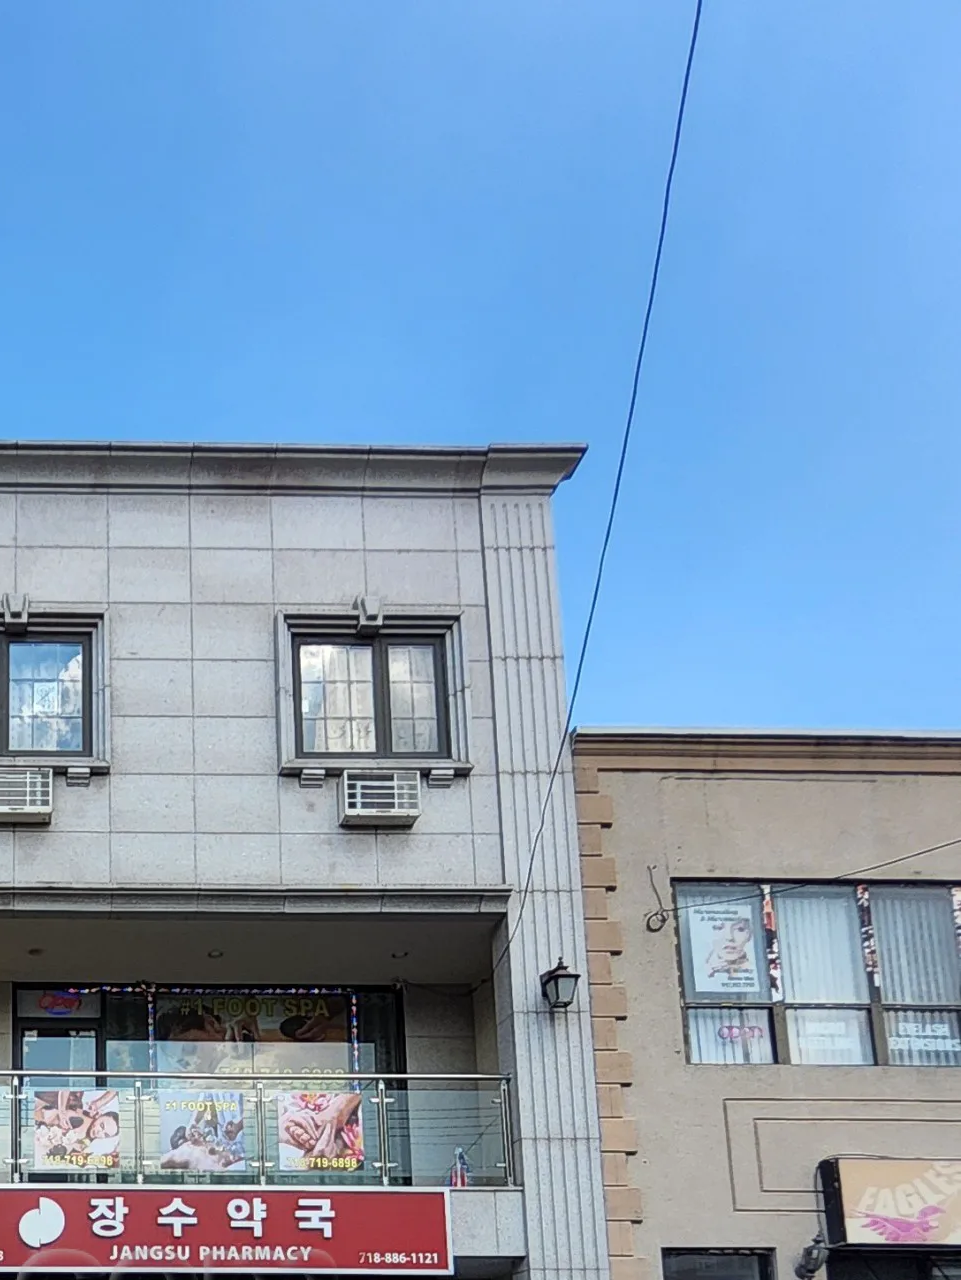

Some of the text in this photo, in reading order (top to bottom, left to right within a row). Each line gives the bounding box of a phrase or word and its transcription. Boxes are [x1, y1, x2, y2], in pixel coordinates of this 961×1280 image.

[180, 998, 331, 1018] #1 FOOT SPA
[181, 1101, 213, 1112] FOOT
[215, 1101, 237, 1112] SPA
[109, 1245, 312, 1262] JANGSU PHARMACY
[358, 1252, 438, 1265] 718-886-1121
